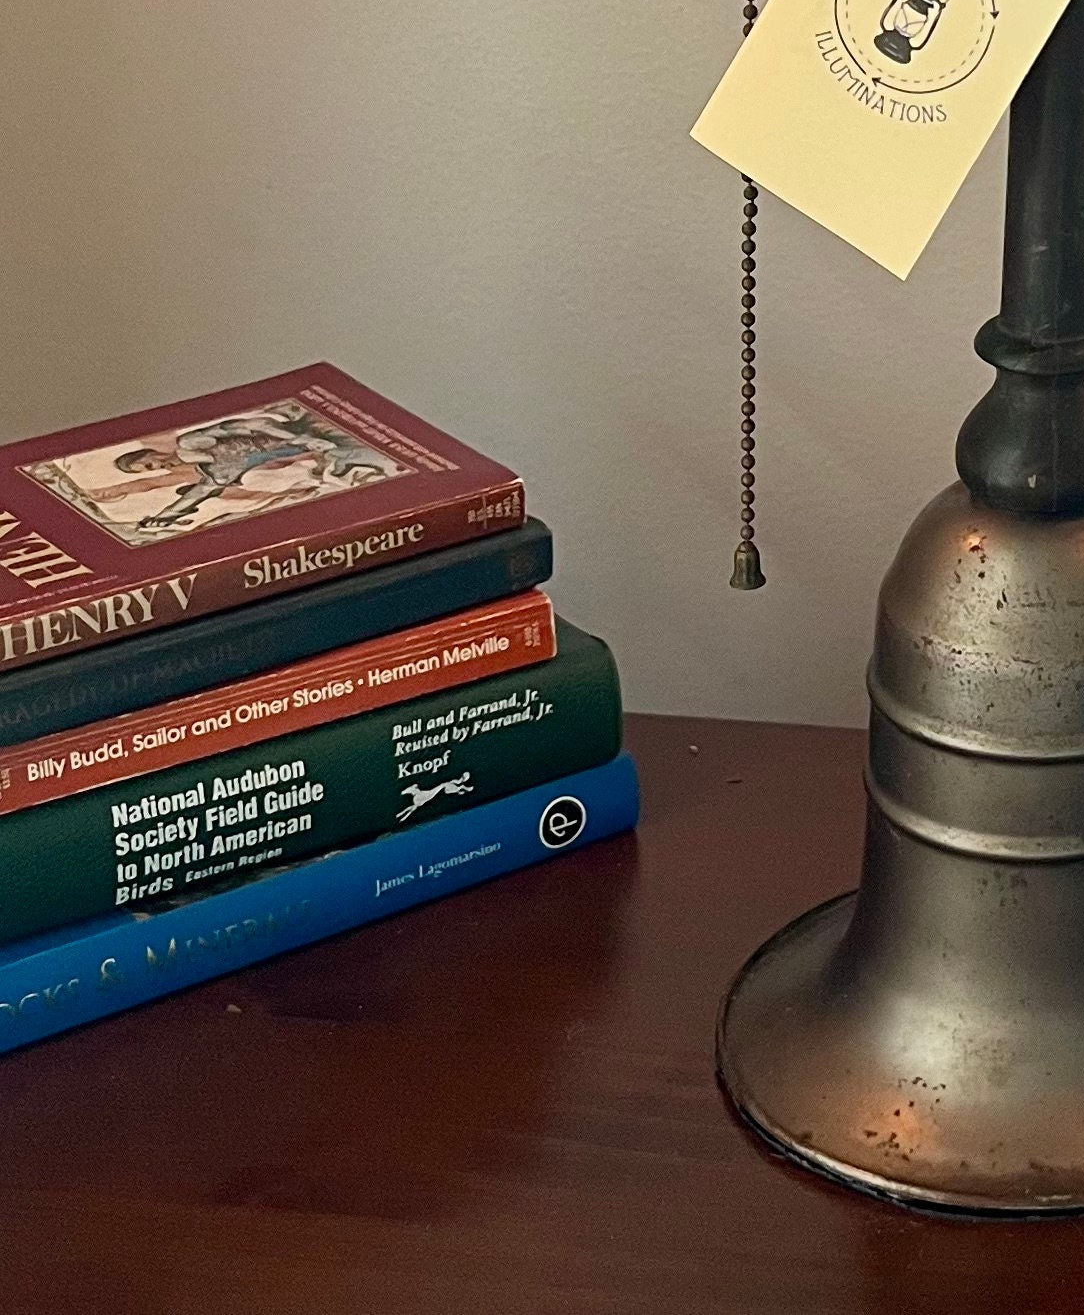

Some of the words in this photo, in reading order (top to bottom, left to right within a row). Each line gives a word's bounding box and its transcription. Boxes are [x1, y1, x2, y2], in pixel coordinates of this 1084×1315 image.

[815, 30, 947, 124] ILLUMINATIONS
[0, 584, 160, 662] HENRY
[165, 573, 198, 611] V
[243, 522, 424, 588] Shakespeare
[27, 757, 65, 782] Billy
[70, 739, 129, 770] Budd,
[133, 723, 187, 753] Sailor
[191, 710, 232, 735] and
[235, 696, 289, 724] Other
[292, 679, 354, 708] Stories
[368, 655, 440, 687] Herman
[443, 635, 510, 666] Melville
[392, 719, 422, 740] Bull
[426, 709, 454, 730] and
[459, 693, 520, 722] Farrand,
[524, 689, 540, 708] Jr.
[394, 728, 449, 757] Revised
[452, 726, 470, 742] by
[471, 706, 534, 736] Farrand,
[535, 702, 554, 721] Jr.
[111, 782, 205, 828] National
[212, 760, 305, 801] Audubon
[397, 750, 452, 780] Knopf
[115, 816, 198, 856] Society
[205, 796, 258, 832] Field
[264, 781, 324, 815] Guide
[116, 862, 138, 883] to
[144, 842, 205, 875] North
[210, 813, 312, 857] American
[115, 876, 173, 905] Birds
[185, 861, 235, 883] Eastern
[238, 847, 283, 867] Region
[376, 874, 415, 898] James
